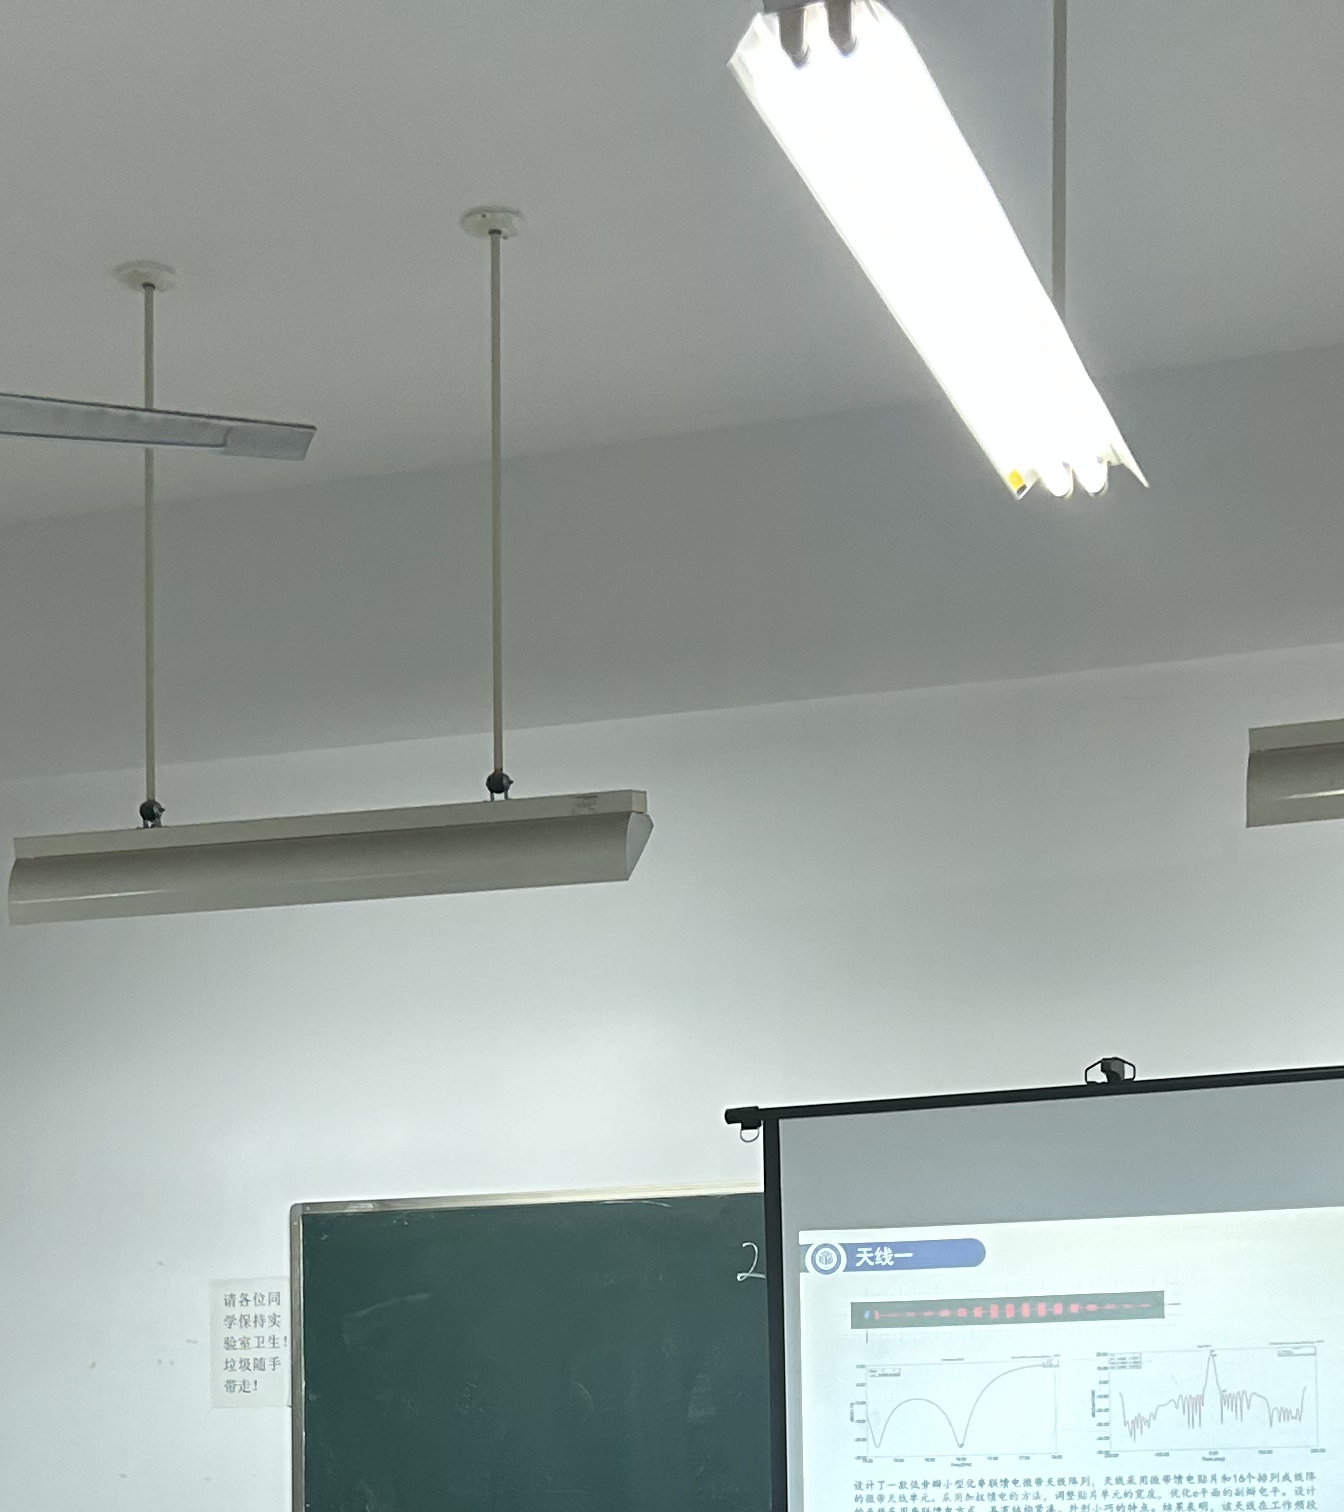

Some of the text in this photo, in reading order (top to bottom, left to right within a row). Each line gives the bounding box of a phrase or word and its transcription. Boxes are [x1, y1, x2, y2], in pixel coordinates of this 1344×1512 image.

[855, 1246, 914, 1267] 天线一
[223, 1291, 282, 1308] 请各位同
[223, 1313, 282, 1330] 学保持实
[223, 1356, 282, 1372] 垃圾随手
